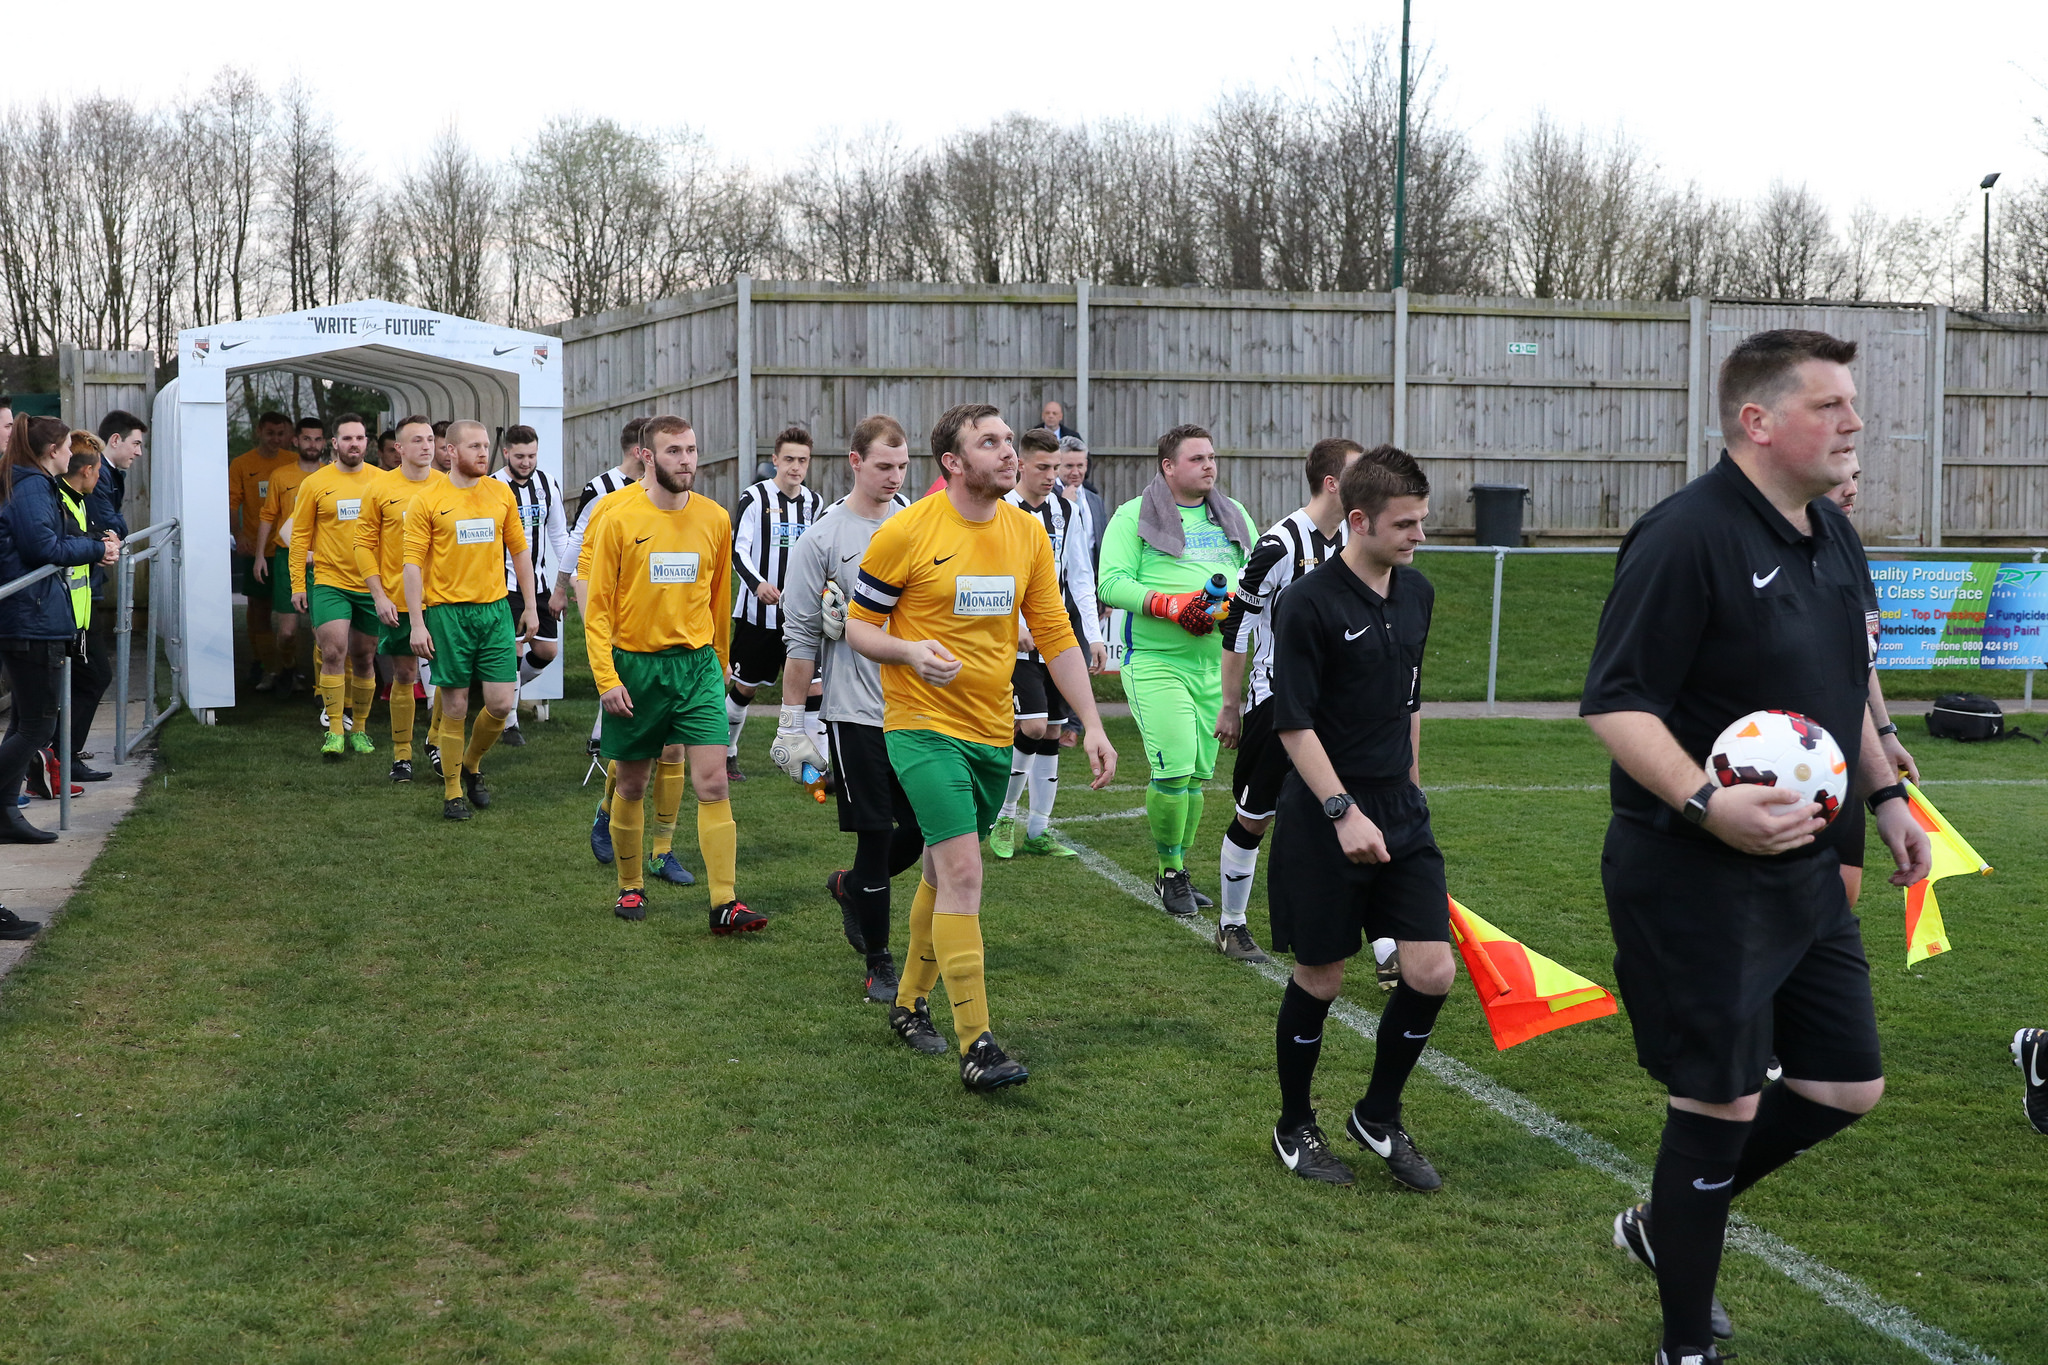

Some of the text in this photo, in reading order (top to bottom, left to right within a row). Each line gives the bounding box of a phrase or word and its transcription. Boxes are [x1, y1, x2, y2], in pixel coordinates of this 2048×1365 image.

[358, 316, 382, 336] The
[460, 526, 493, 539] MONARCH
[653, 564, 696, 577] MONARCH
[1868, 567, 1978, 583] uality Products,
[959, 590, 1013, 608] MONARCH
[1236, 588, 1261, 605] APTAIN
[1888, 585, 1926, 599] Class
[1930, 586, 1983, 600] Surface
[1879, 609, 1901, 619] eed
[1911, 609, 1931, 621] Top
[1934, 609, 1987, 623] Dressings
[1880, 624, 1936, 635] Herbicides
[1946, 625, 2011, 638] Linemarking
[2014, 625, 2040, 636] Paint
[1921, 641, 1960, 651] Freefone
[1962, 641, 1984, 651] 0800
[1985, 641, 2001, 651] 424
[2002, 641, 2019, 651] 919
[1889, 656, 1925, 667] product
[1926, 656, 1968, 667] suppliers
[1970, 656, 1980, 665] to
[1981, 656, 1996, 665] the
[1997, 656, 2029, 665] Norfolk
[2031, 656, 2044, 665] FA
[1156, 750, 1165, 770] 1
